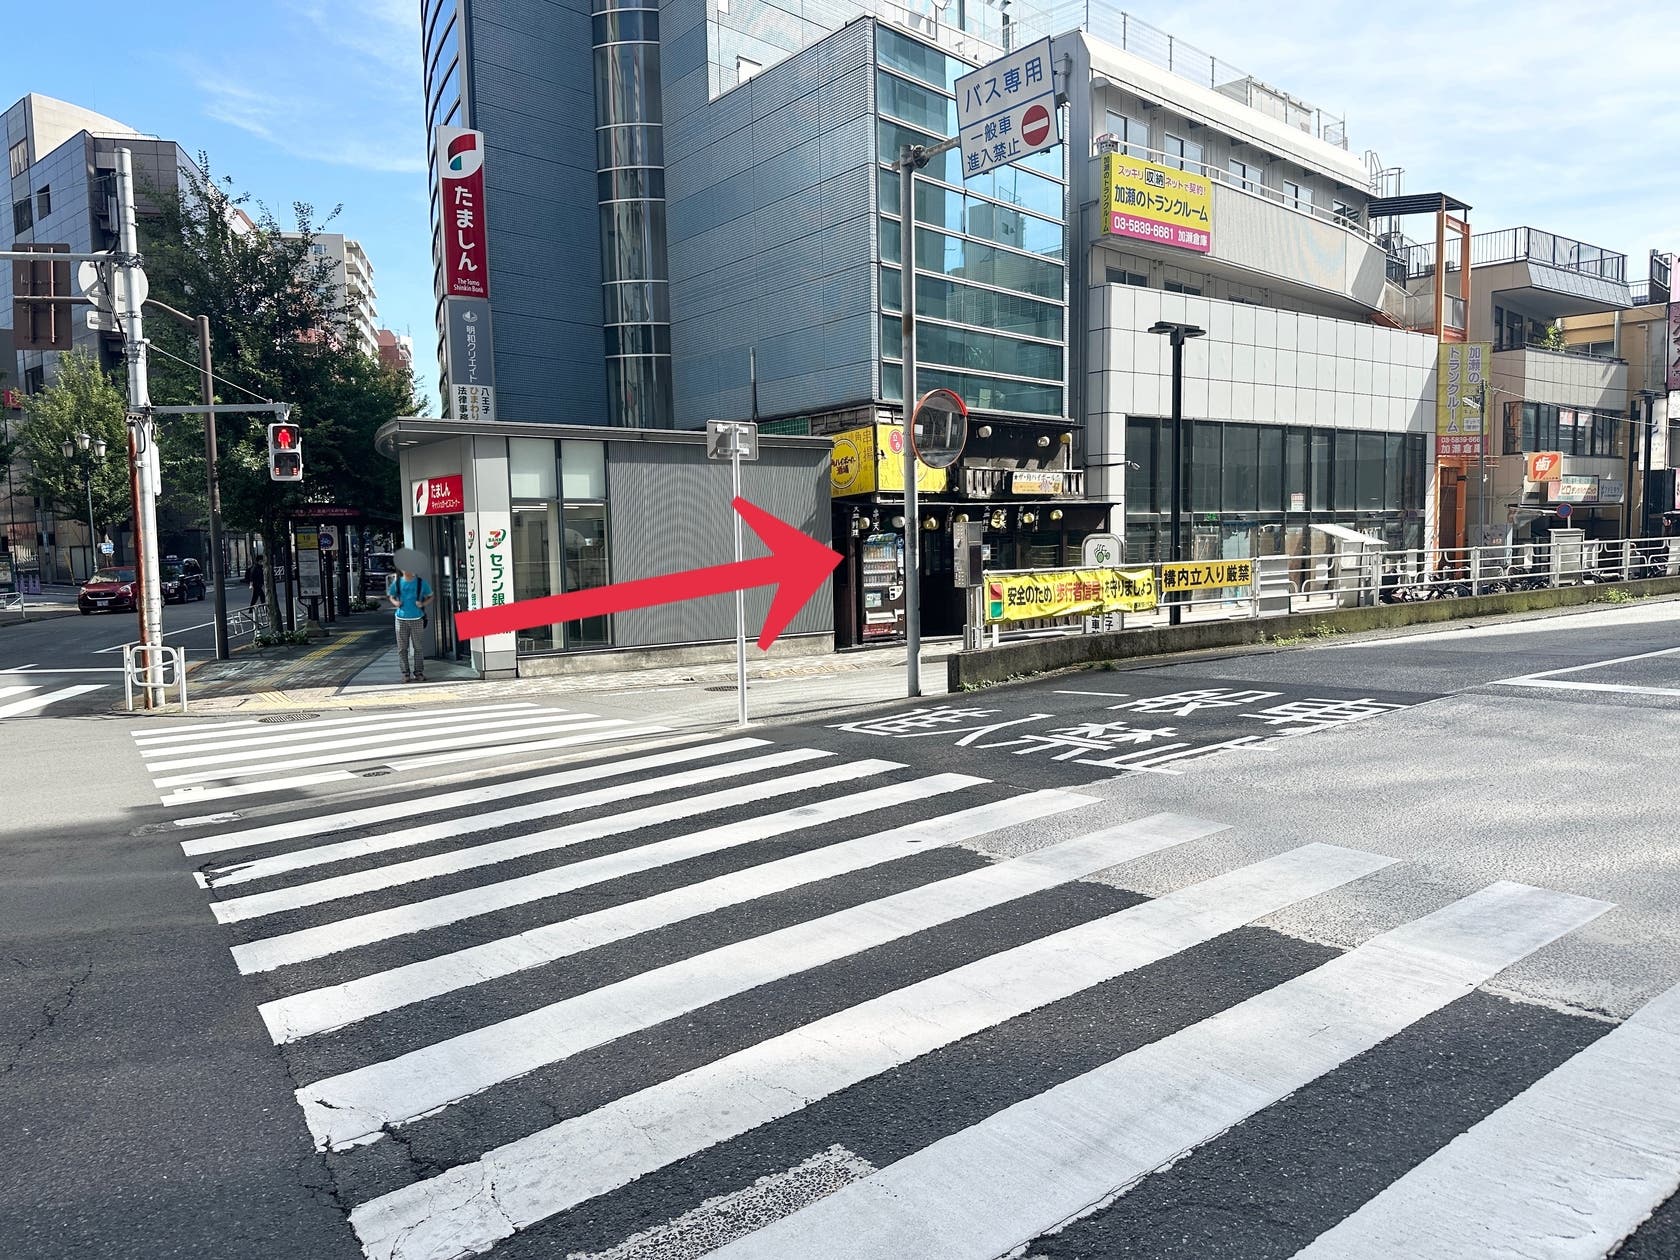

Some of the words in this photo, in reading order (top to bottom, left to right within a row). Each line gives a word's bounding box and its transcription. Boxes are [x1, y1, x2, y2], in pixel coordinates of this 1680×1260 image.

[965, 56, 1043, 113] バス専用
[970, 115, 1013, 142] 一般車
[967, 137, 1021, 172] 進入禁止
[1114, 184, 1209, 222] 加瀬のトランクルーム
[454, 185, 478, 272] たましん
[1114, 216, 1174, 240] 03-5839-6661
[1178, 230, 1208, 246] 加瀬倉庫
[1468, 346, 1480, 383] 加瀬の
[481, 387, 491, 414] 八王子
[1447, 346, 1460, 433] トランクルーム
[1440, 436, 1481, 444] 03-5839-666
[1535, 457, 1551, 471] 歯
[431, 482, 451, 498] たましん
[1163, 564, 1250, 588] 構内立入り厳禁
[825, 705, 1278, 775] 進入禁止
